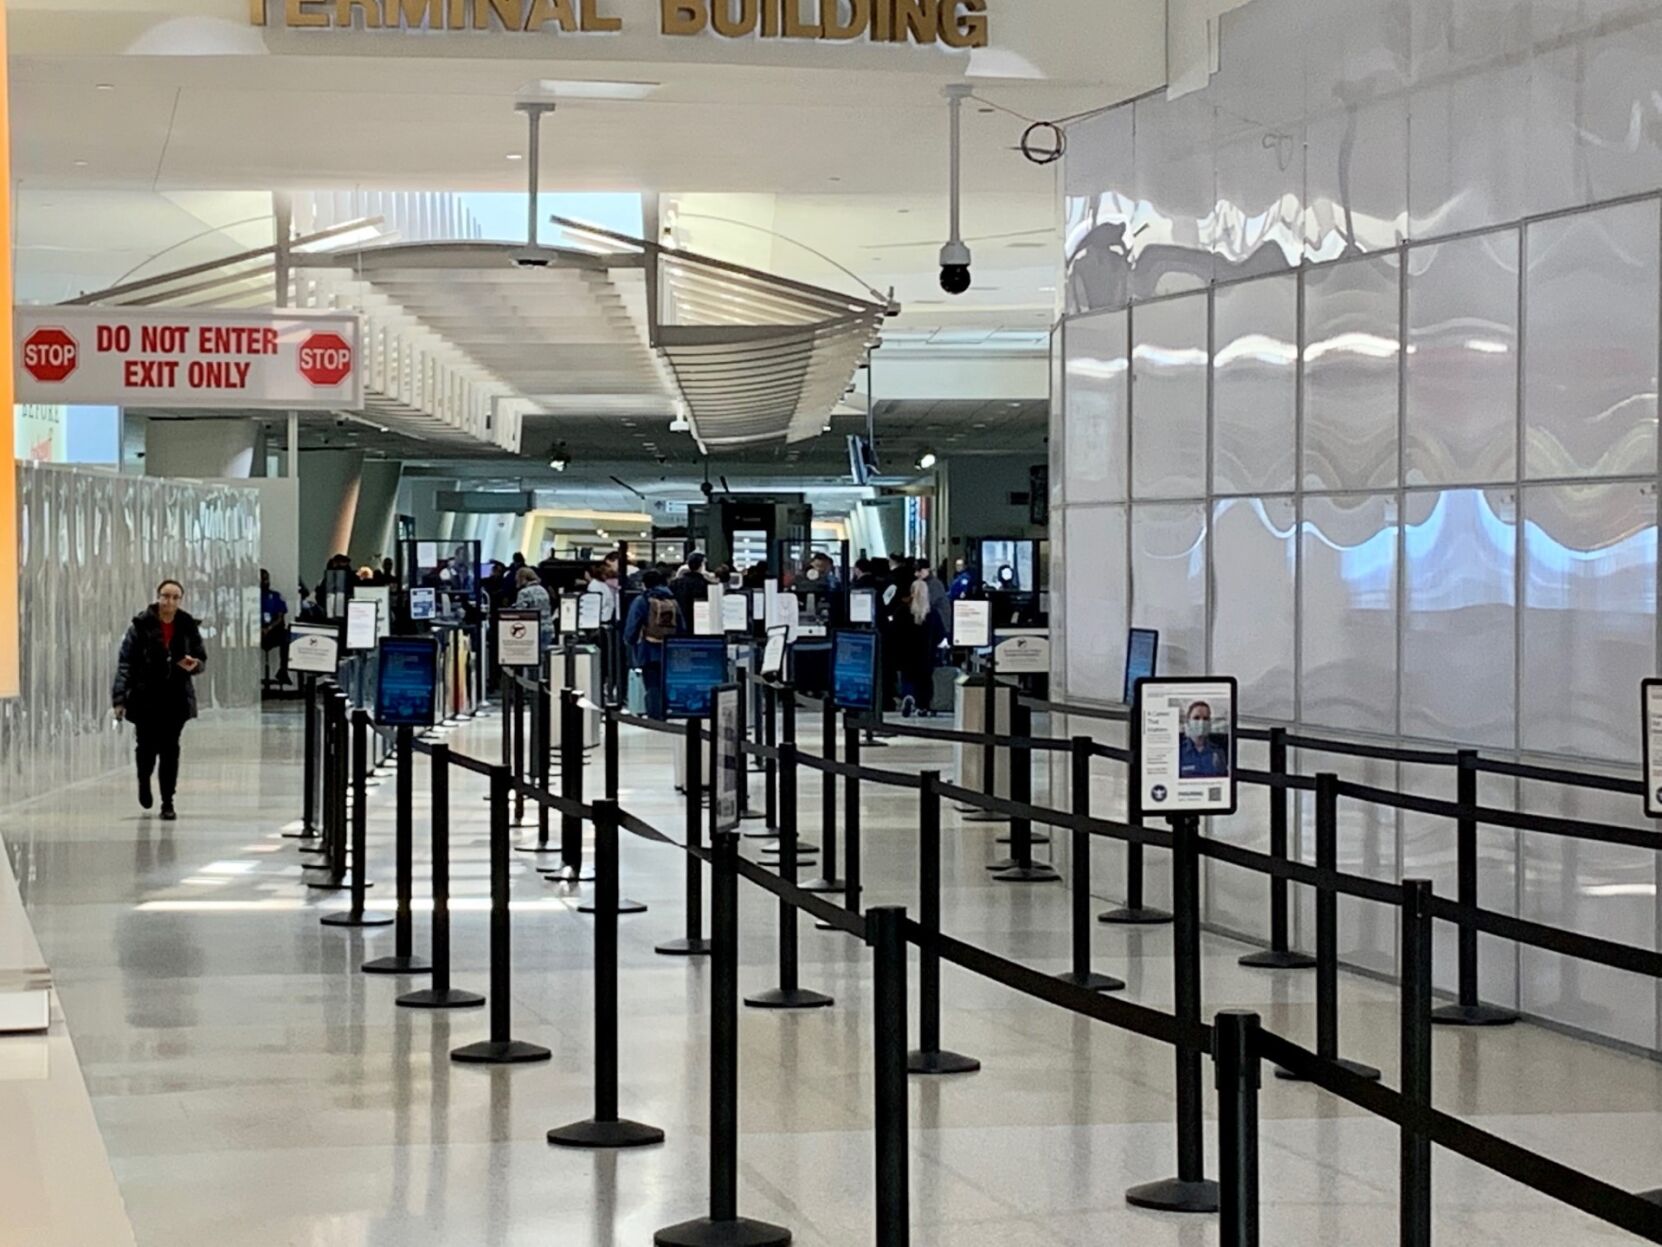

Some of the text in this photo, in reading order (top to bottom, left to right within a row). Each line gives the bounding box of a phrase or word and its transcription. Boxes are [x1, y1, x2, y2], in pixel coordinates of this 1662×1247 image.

[661, 0, 988, 48] BUILDING
[96, 325, 279, 355] DO NOT ENTER
[25, 344, 76, 366] STOP
[301, 348, 350, 370] STOP
[124, 360, 251, 389] EXIT ONLY
